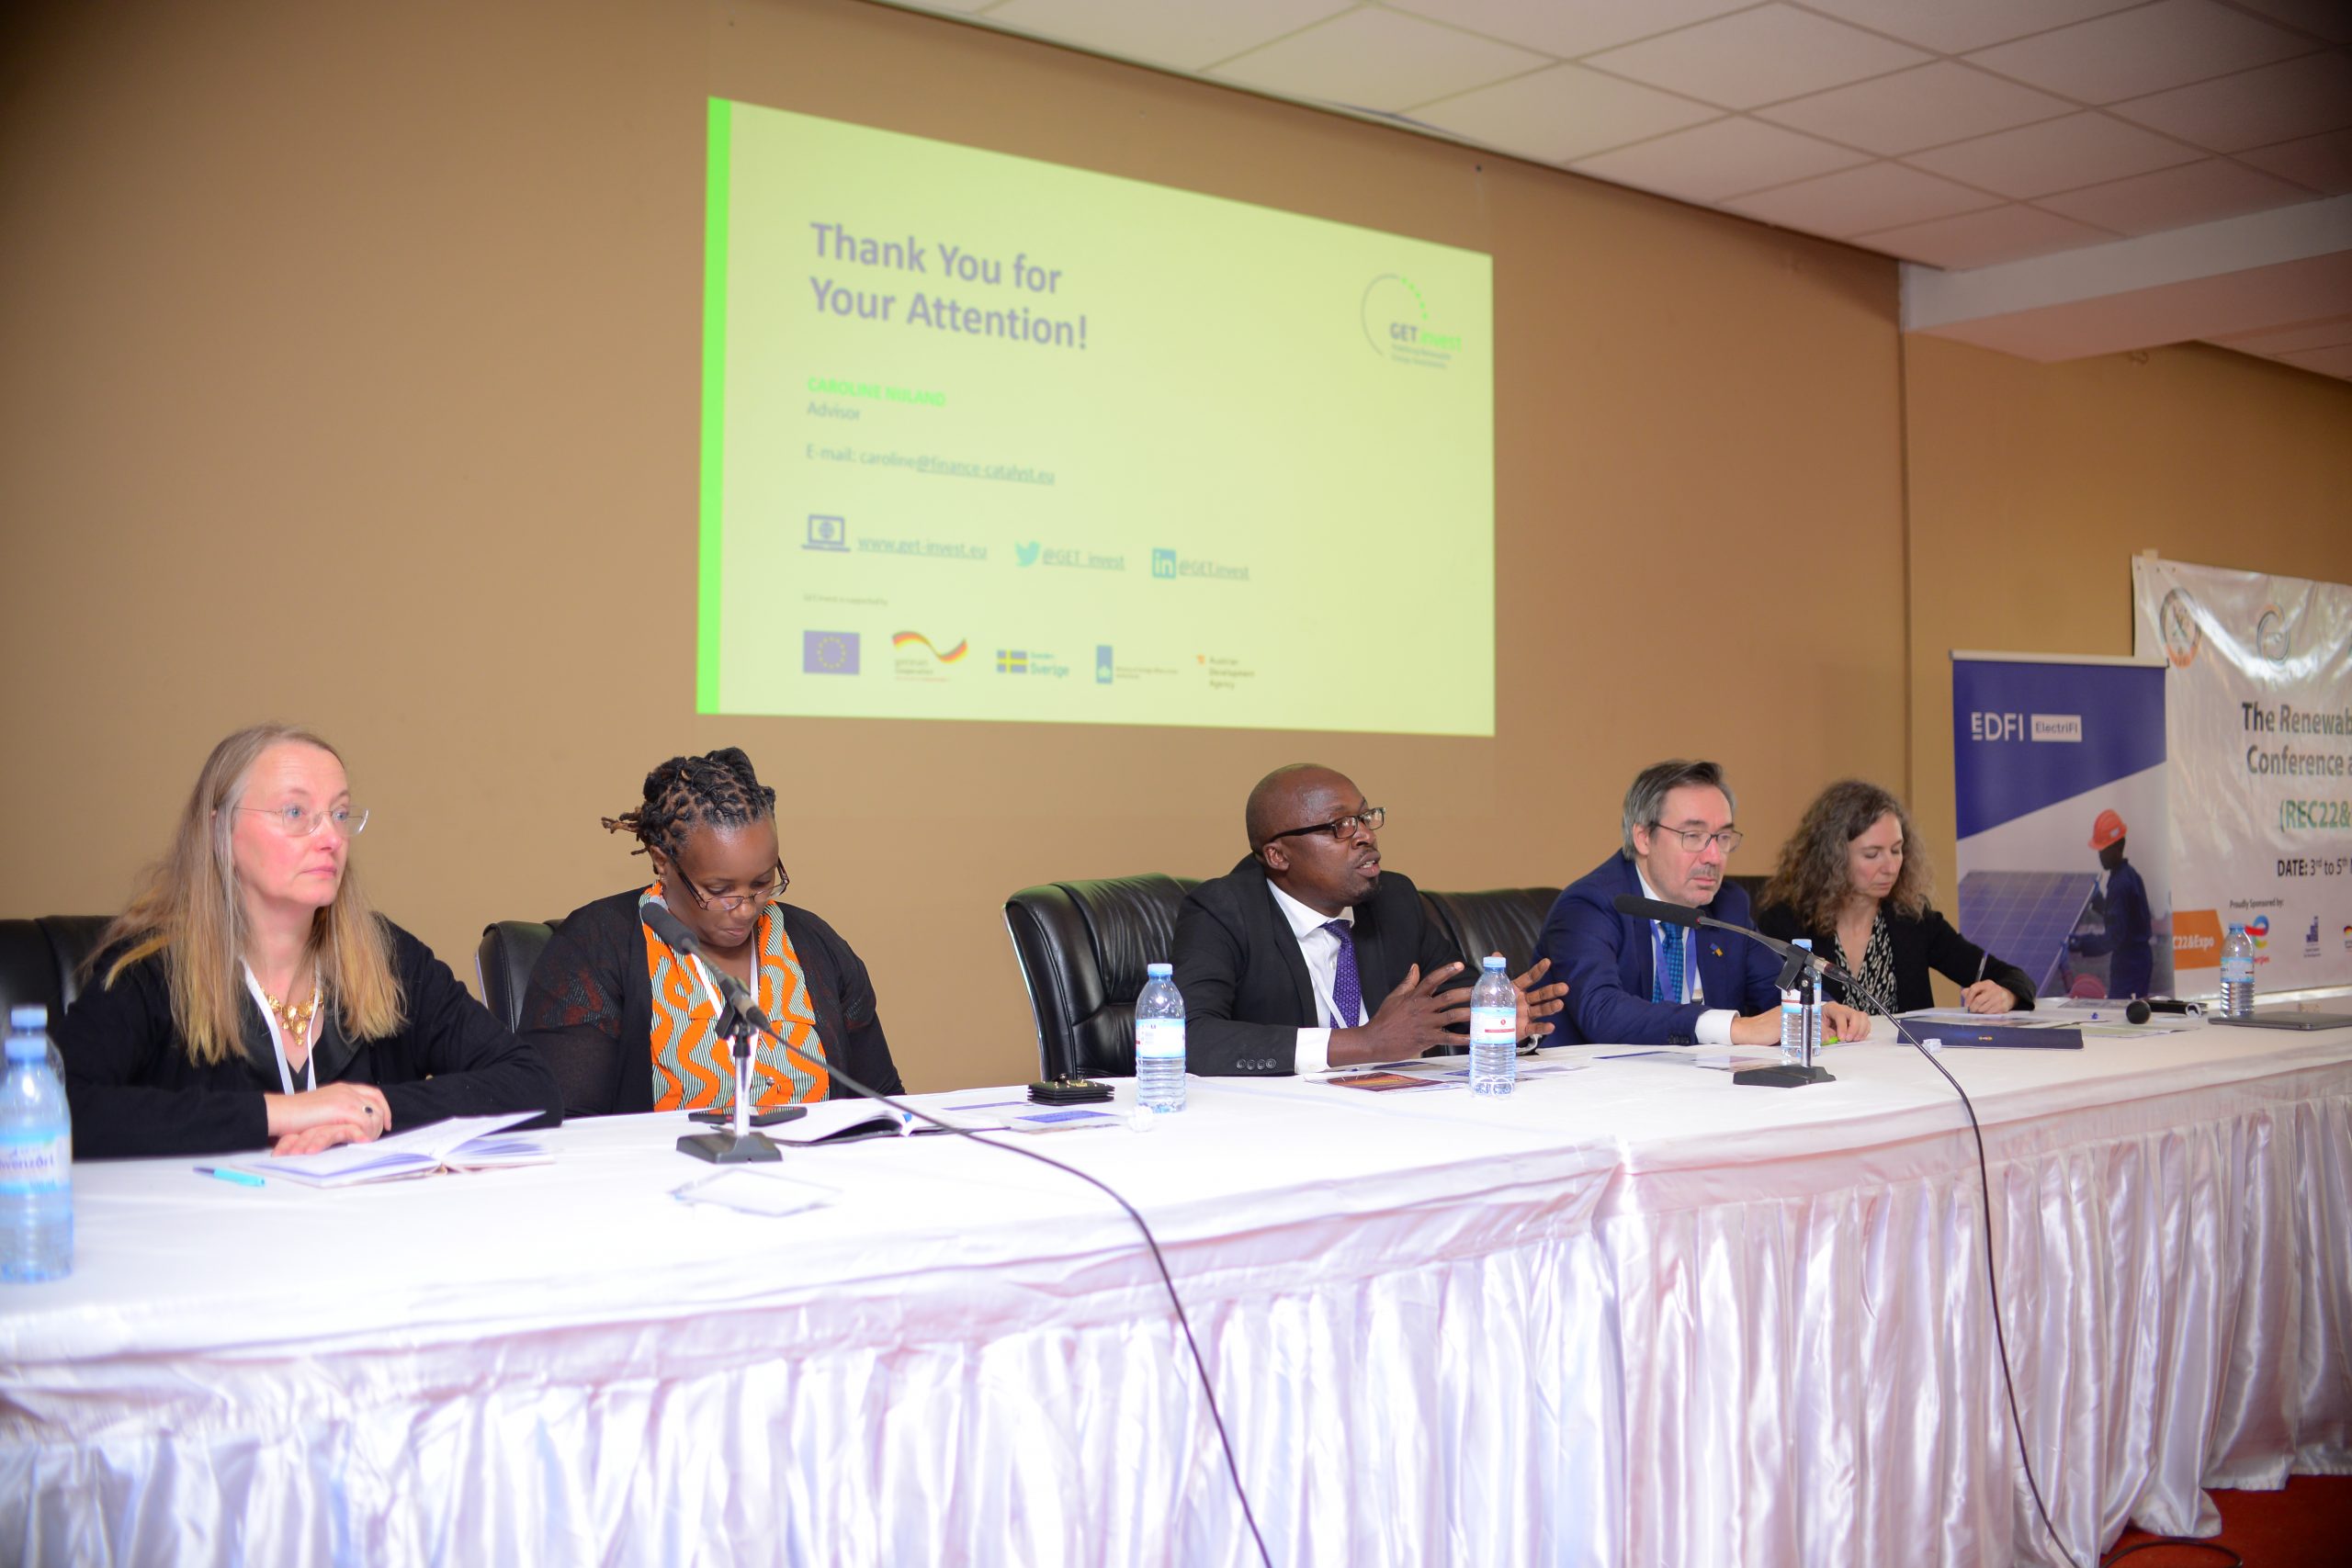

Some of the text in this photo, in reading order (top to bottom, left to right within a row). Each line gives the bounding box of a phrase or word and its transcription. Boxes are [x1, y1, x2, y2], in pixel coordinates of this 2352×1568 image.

[809, 221, 1062, 294] Thank You for
[809, 276, 1088, 350] Your Attention!
[1390, 322, 1418, 343] GET
[808, 376, 882, 400] CAROLINE
[808, 401, 861, 421] Advisor
[806, 444, 856, 464] E-mail:
[1971, 712, 2024, 741] EDFI
[2242, 701, 2275, 732] The
[2246, 744, 2344, 776] Conference
[2278, 858, 2308, 877] DATE:
[2324, 861, 2335, 875] to
[2230, 899, 2249, 910] Proudly
[2250, 897, 2276, 909] Sponsored
